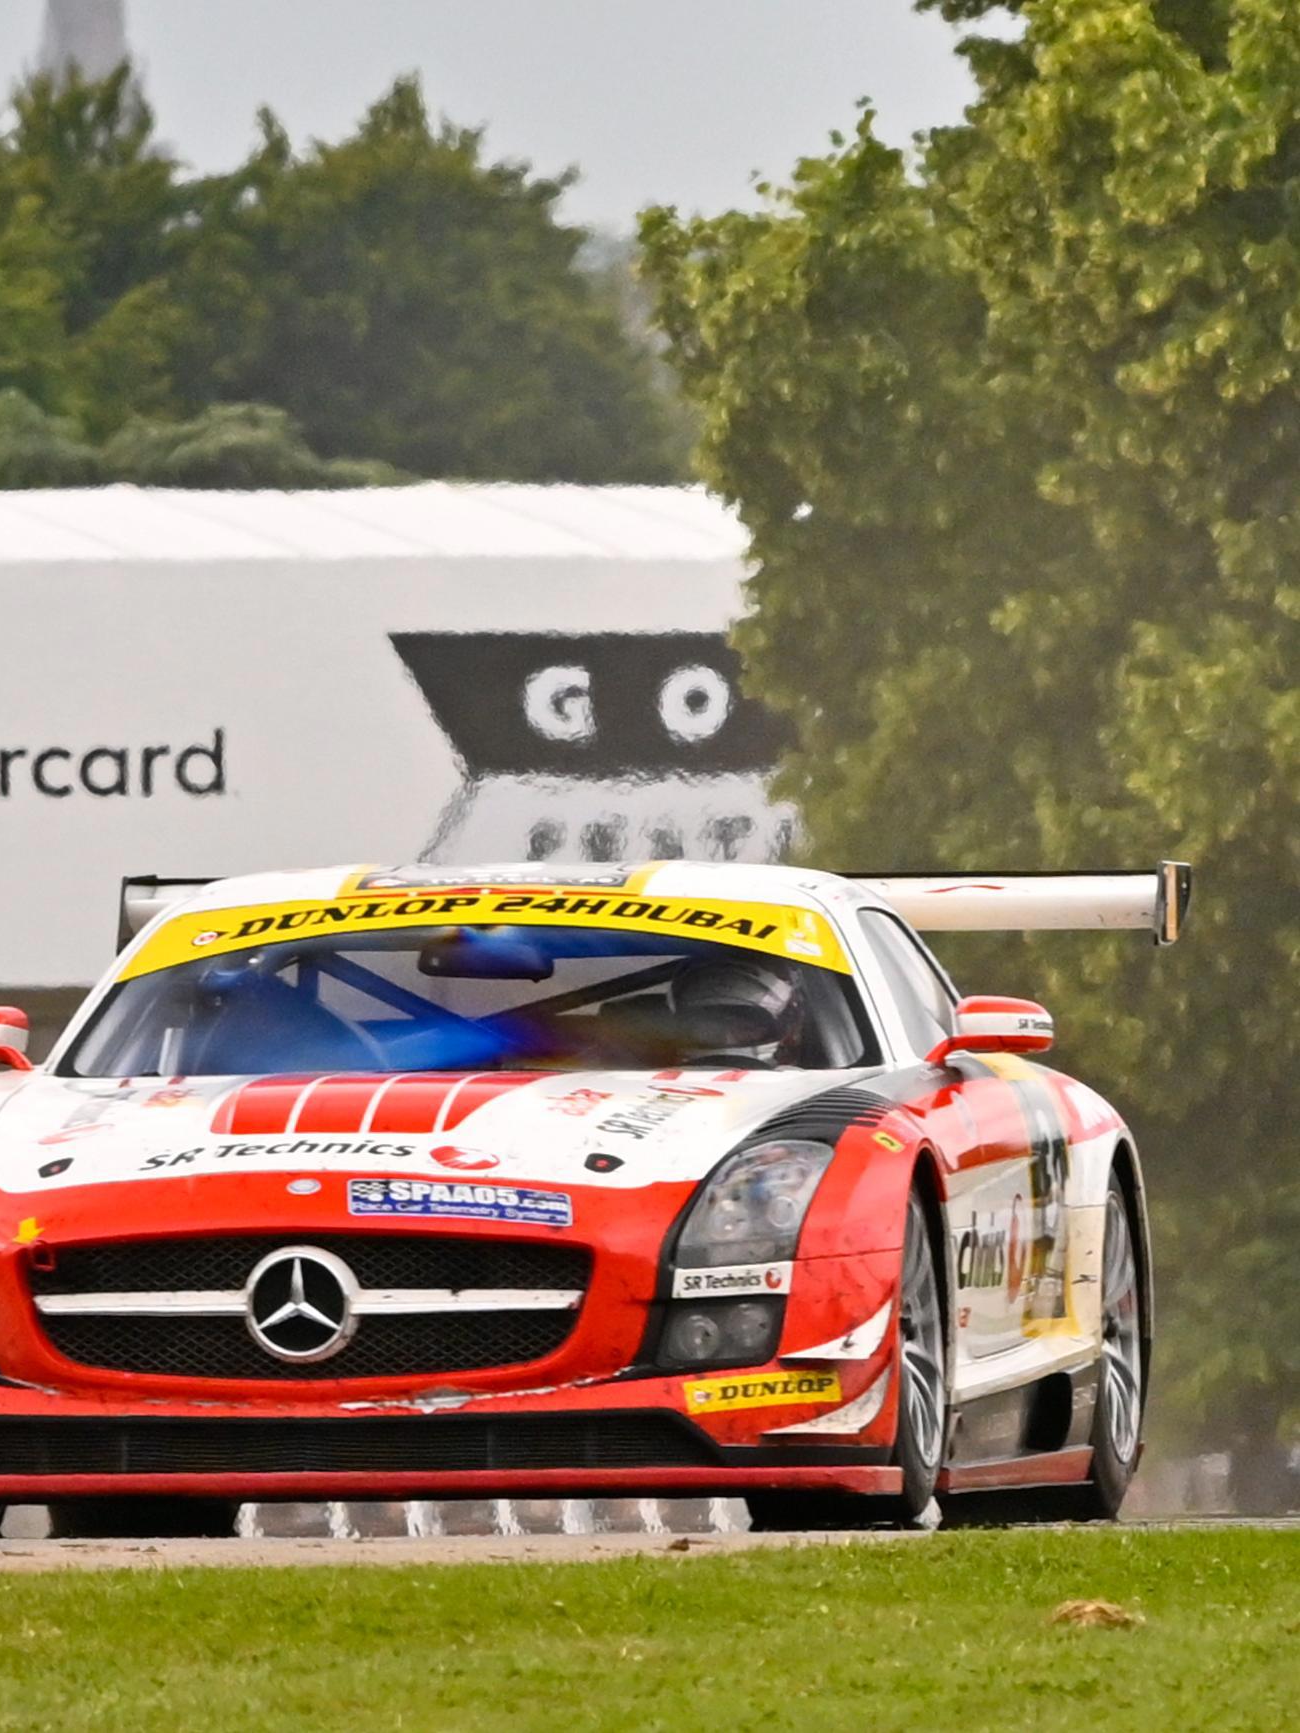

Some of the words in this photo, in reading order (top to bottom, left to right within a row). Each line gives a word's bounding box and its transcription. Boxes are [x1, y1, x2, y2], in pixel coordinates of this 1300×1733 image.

[230, 897, 480, 940] DUNLOP
[610, 900, 779, 940] DUBAI
[139, 1147, 206, 1171] SR
[216, 1139, 416, 1158] Technics
[351, 1201, 393, 1212] Race
[396, 1202, 425, 1213] Car
[430, 1203, 500, 1219] Telemetry
[683, 1275, 702, 1291] SR
[706, 1270, 762, 1290] Technics
[719, 1377, 835, 1401] DUNLOP
